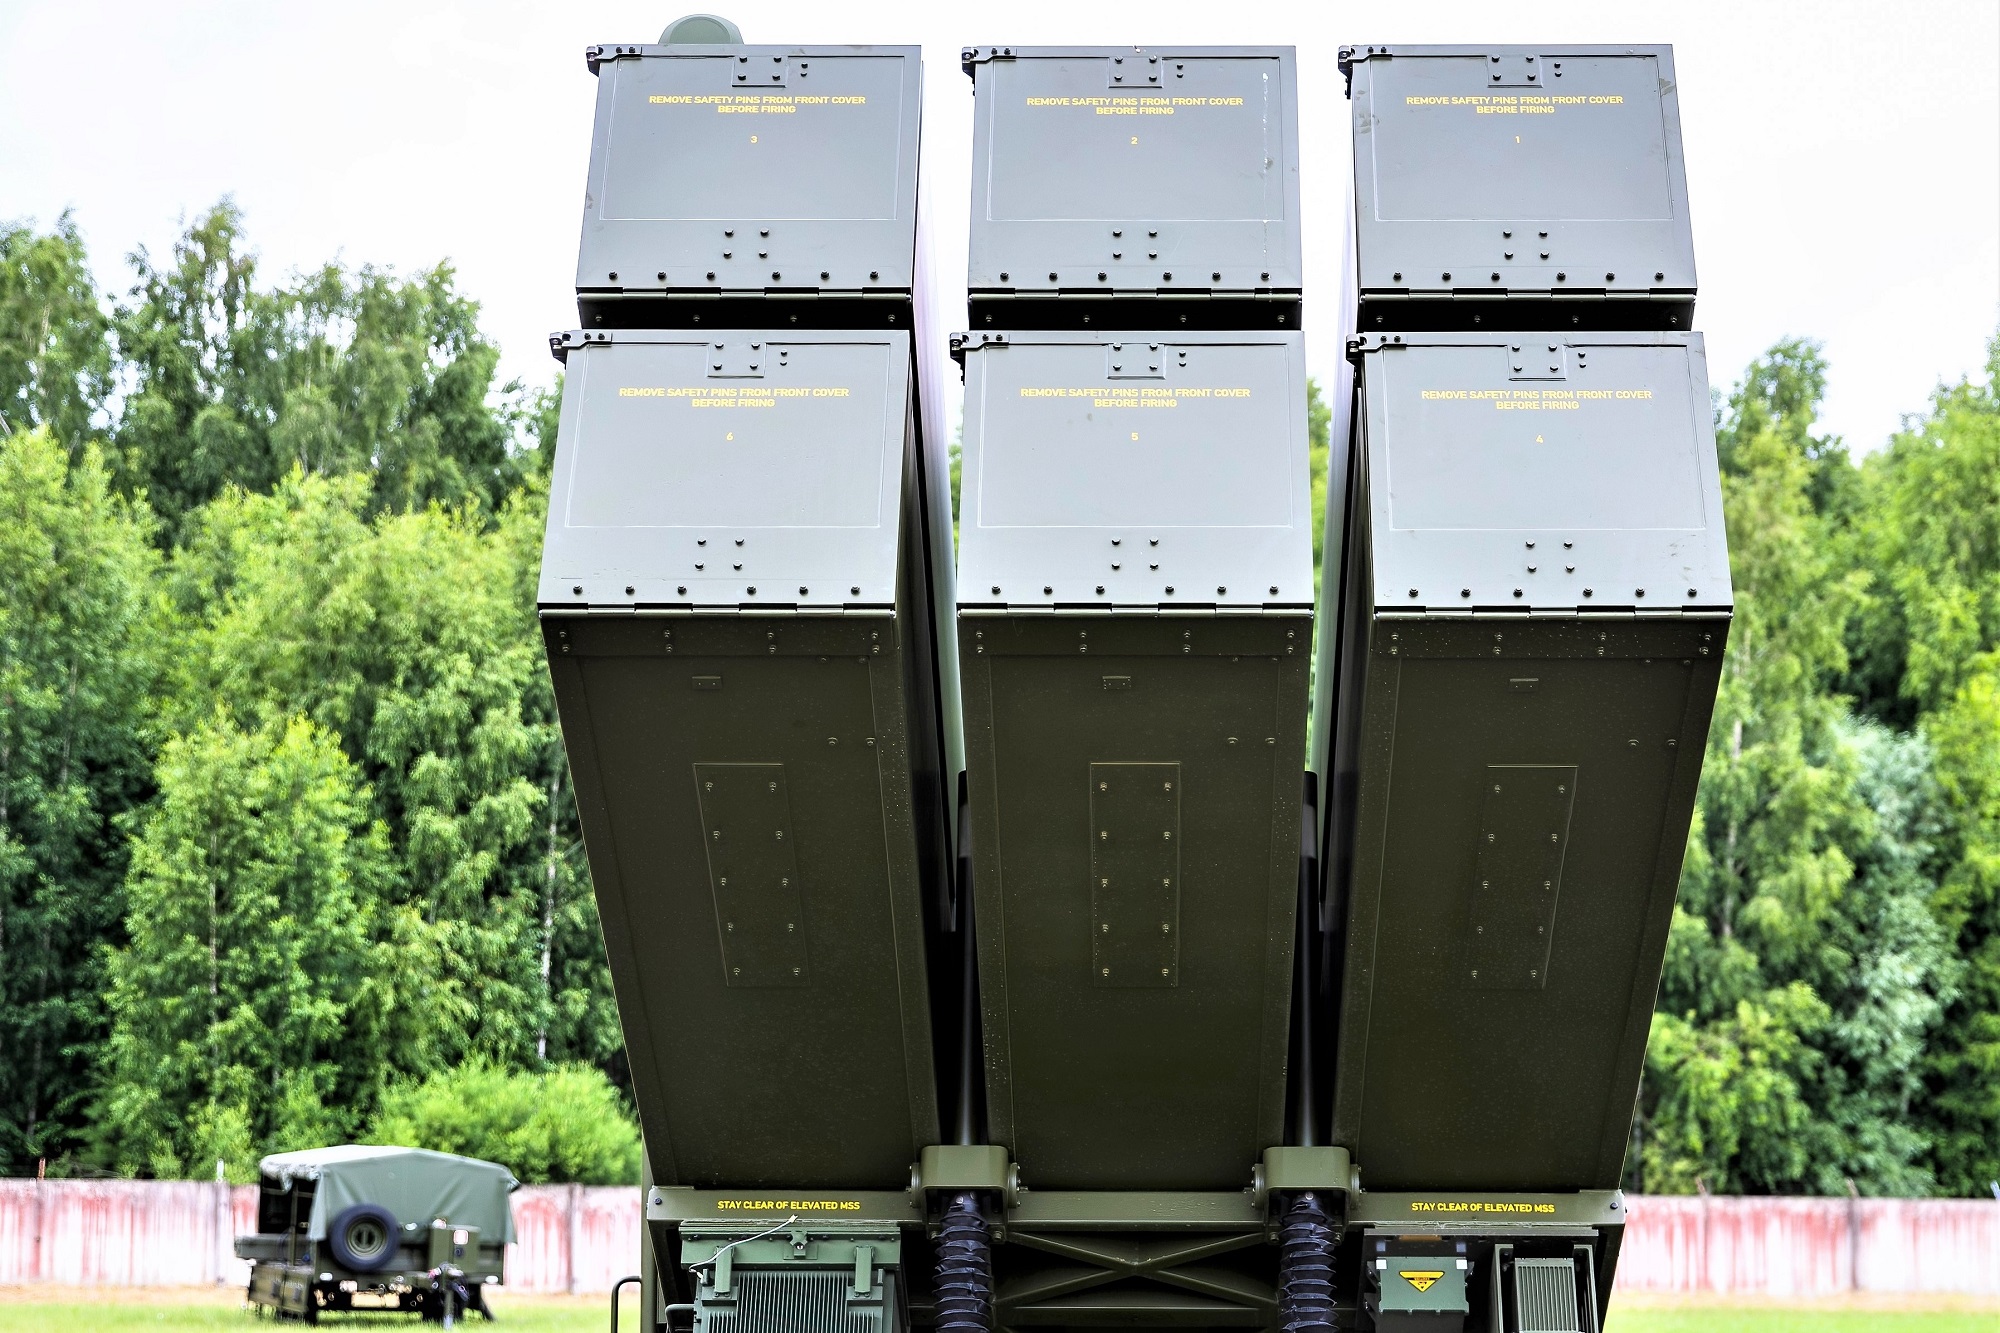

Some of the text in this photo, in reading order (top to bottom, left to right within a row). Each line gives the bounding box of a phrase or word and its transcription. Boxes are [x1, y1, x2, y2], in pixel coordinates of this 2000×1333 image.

[648, 96, 866, 104] REMOVE SAFETY PINS FROM FRONT COVER
[1026, 97, 1243, 106] REMOVE SAFETY PINS FROM FRONT COVER
[1520, 96, 1550, 104] FROM
[1552, 96, 1587, 104] FRONT
[1589, 96, 1623, 104] COVER
[718, 105, 796, 113] BEFORE FIRING
[1096, 106, 1174, 115] BEFORE FIRING
[1131, 136, 1138, 145] 2
[619, 388, 849, 397] REMOVE SAFETY PINS FROM FRONT COVER
[1020, 388, 1250, 397] REMOVE SAFETY PINS FROM FRONT COVER
[1422, 391, 1652, 399] REMOVE SAFETY PINS FROM FRONT COVER
[692, 398, 775, 407] BEFORE FIRING
[1094, 398, 1177, 407] BEFORE FIRING
[1496, 401, 1579, 410] BEFORE FIRING
[726, 432, 734, 441] 6
[1131, 432, 1139, 441] 5
[1536, 435, 1544, 445] 4
[717, 1200, 860, 1210] STAY CLEAR OF ELEVATED MSS
[1411, 1202, 1555, 1213] STAY CLEAR OF ELEVATED MSS
